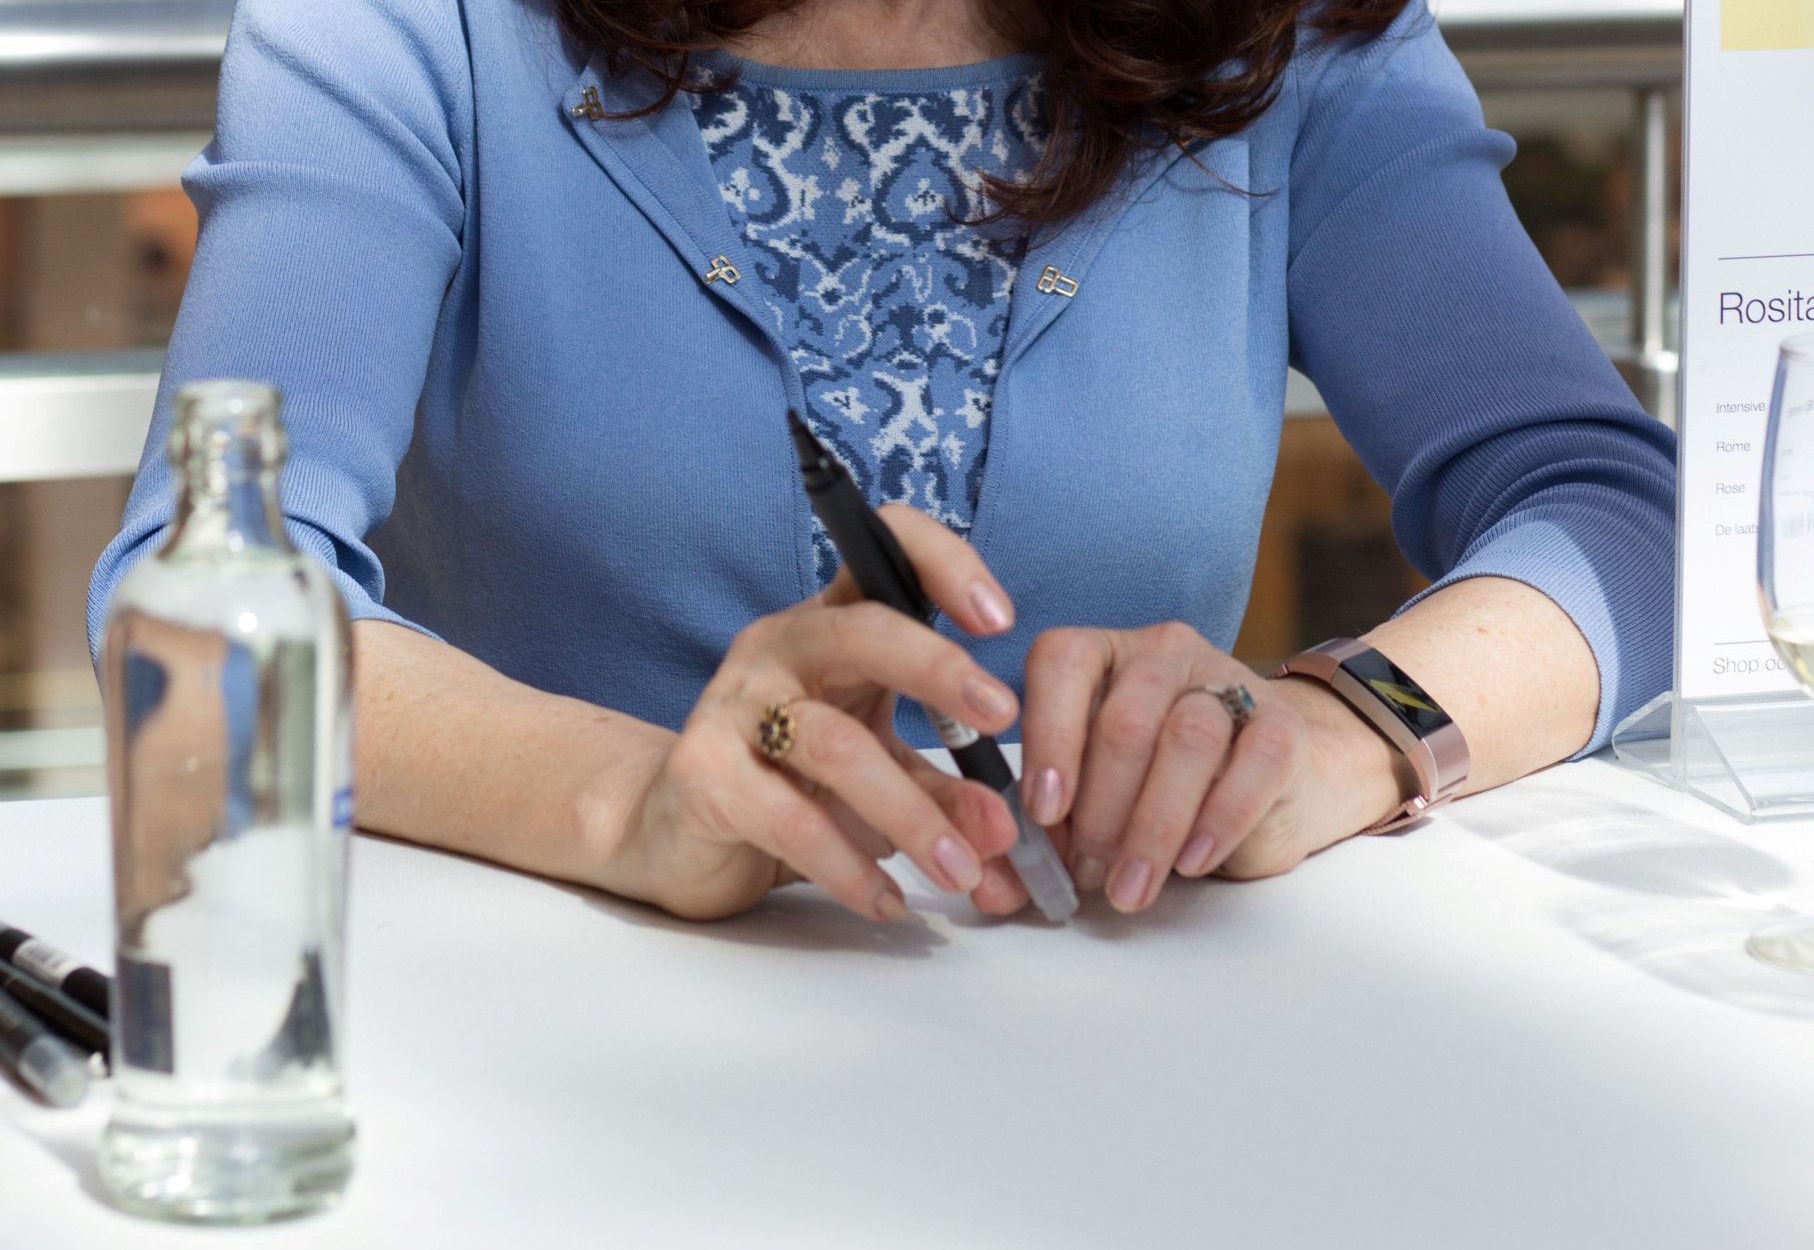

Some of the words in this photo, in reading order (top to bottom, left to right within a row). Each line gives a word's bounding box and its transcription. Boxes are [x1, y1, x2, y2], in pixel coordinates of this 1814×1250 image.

[1716, 401, 1766, 414] Intensive
[1716, 441, 1751, 453] Rome
[1715, 482, 1746, 494] Rose
[1715, 524, 1732, 536] De
[1713, 657, 1759, 675] Shop
